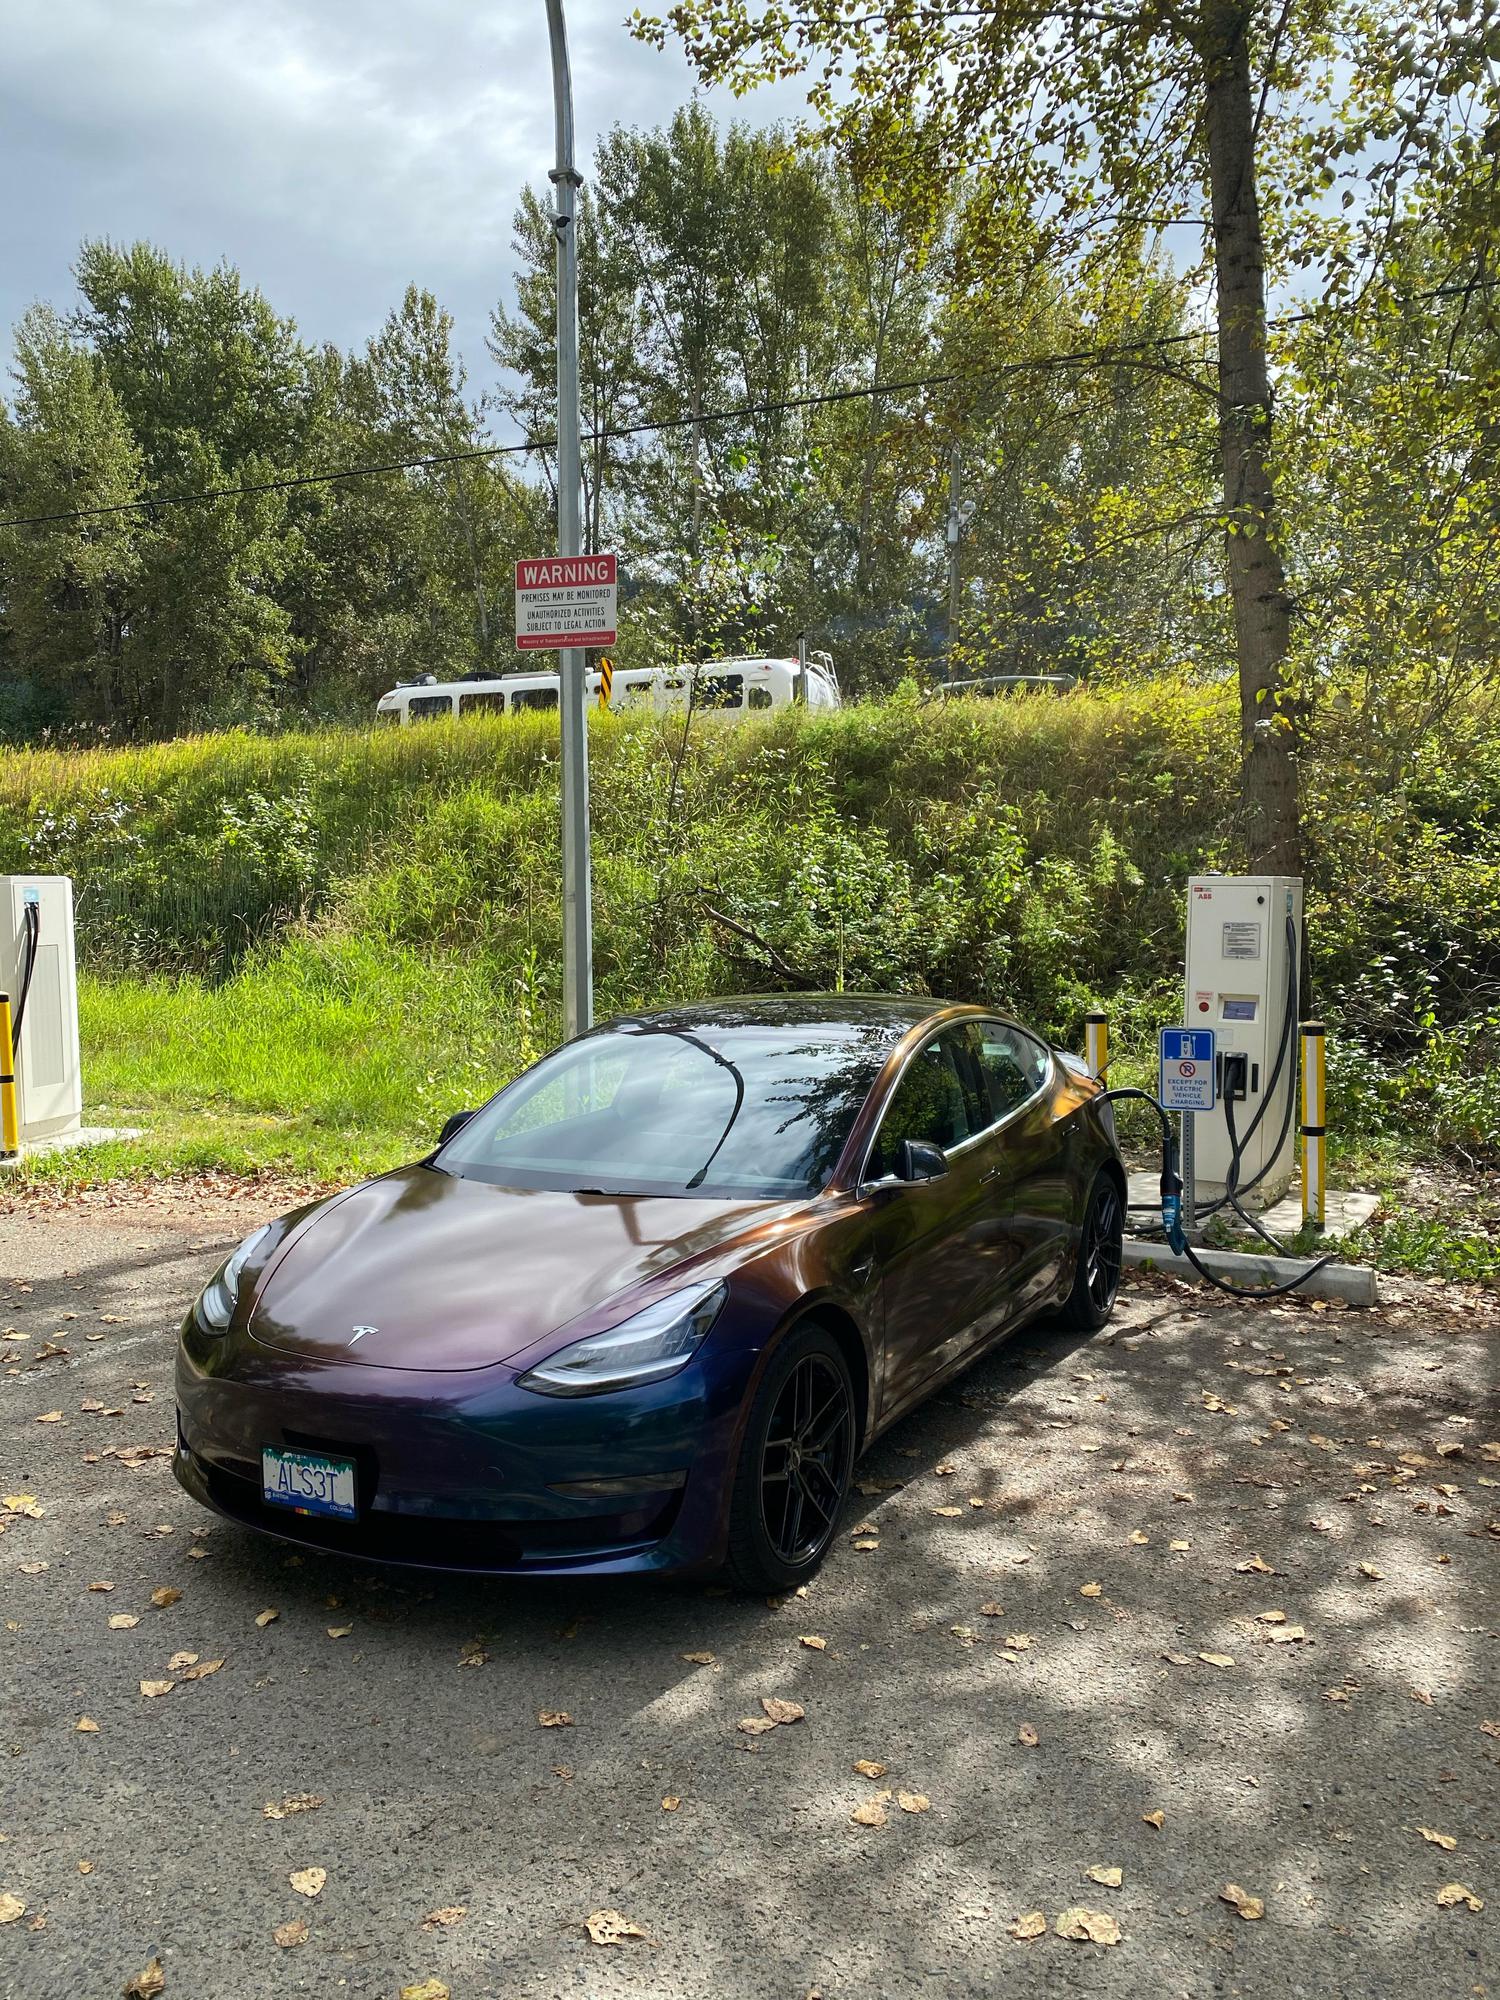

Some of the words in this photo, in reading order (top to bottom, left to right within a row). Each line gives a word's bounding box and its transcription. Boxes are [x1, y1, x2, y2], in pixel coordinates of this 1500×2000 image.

[524, 561, 608, 585] WARNING
[521, 592, 550, 603] PREMISES
[552, 591, 564, 601] MAY
[566, 591, 575, 600] BE
[577, 589, 610, 599] MONITORED
[527, 608, 572, 620] UNAUTHORIZED
[573, 607, 605, 617] ACTIVITIES
[526, 621, 552, 632] SUBJECT
[554, 621, 561, 630] TO
[564, 620, 582, 629] LEGAL
[584, 619, 606, 628] ACTION
[278, 1462, 338, 1501] ALS3T
